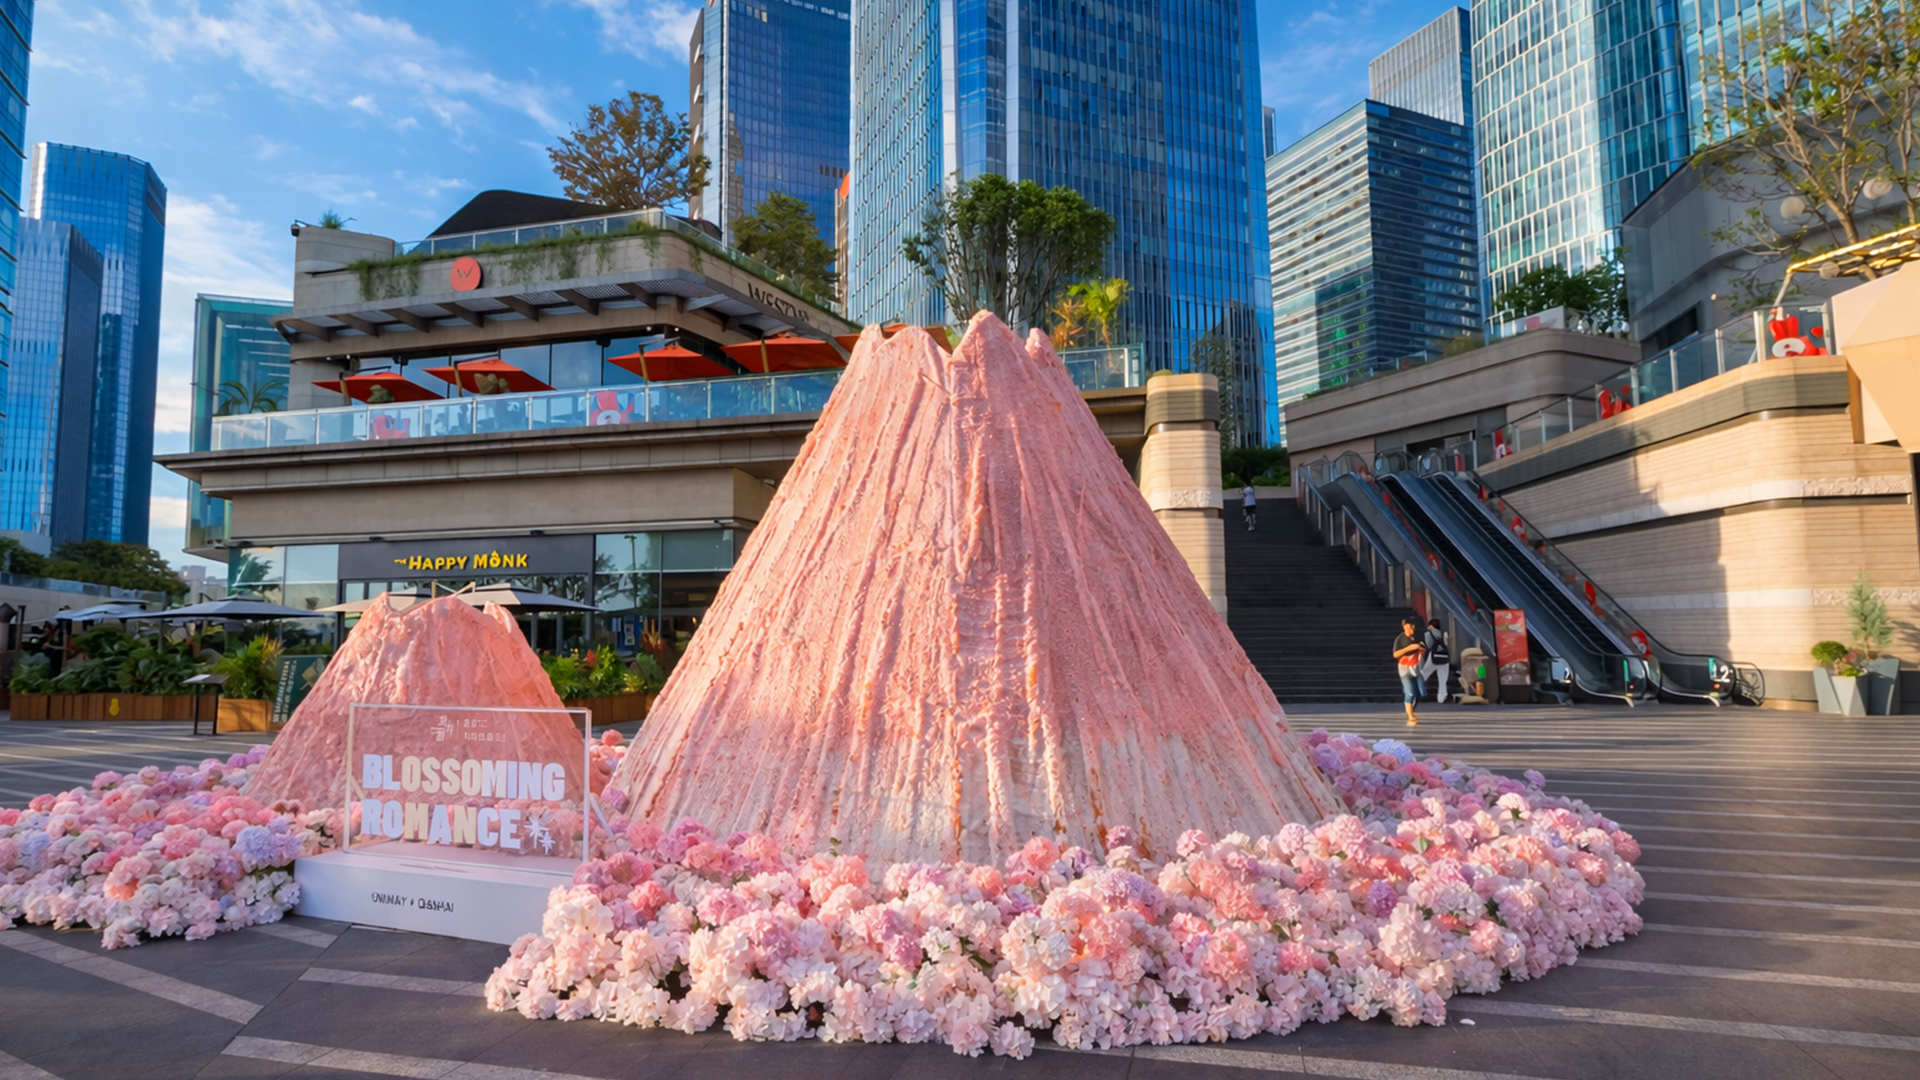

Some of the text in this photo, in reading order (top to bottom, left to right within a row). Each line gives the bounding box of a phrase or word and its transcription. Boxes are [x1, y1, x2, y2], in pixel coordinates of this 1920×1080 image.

[408, 555, 467, 570] HAPPY
[363, 754, 565, 802] BLOSSOMING
[362, 799, 521, 848] ROMANCE
